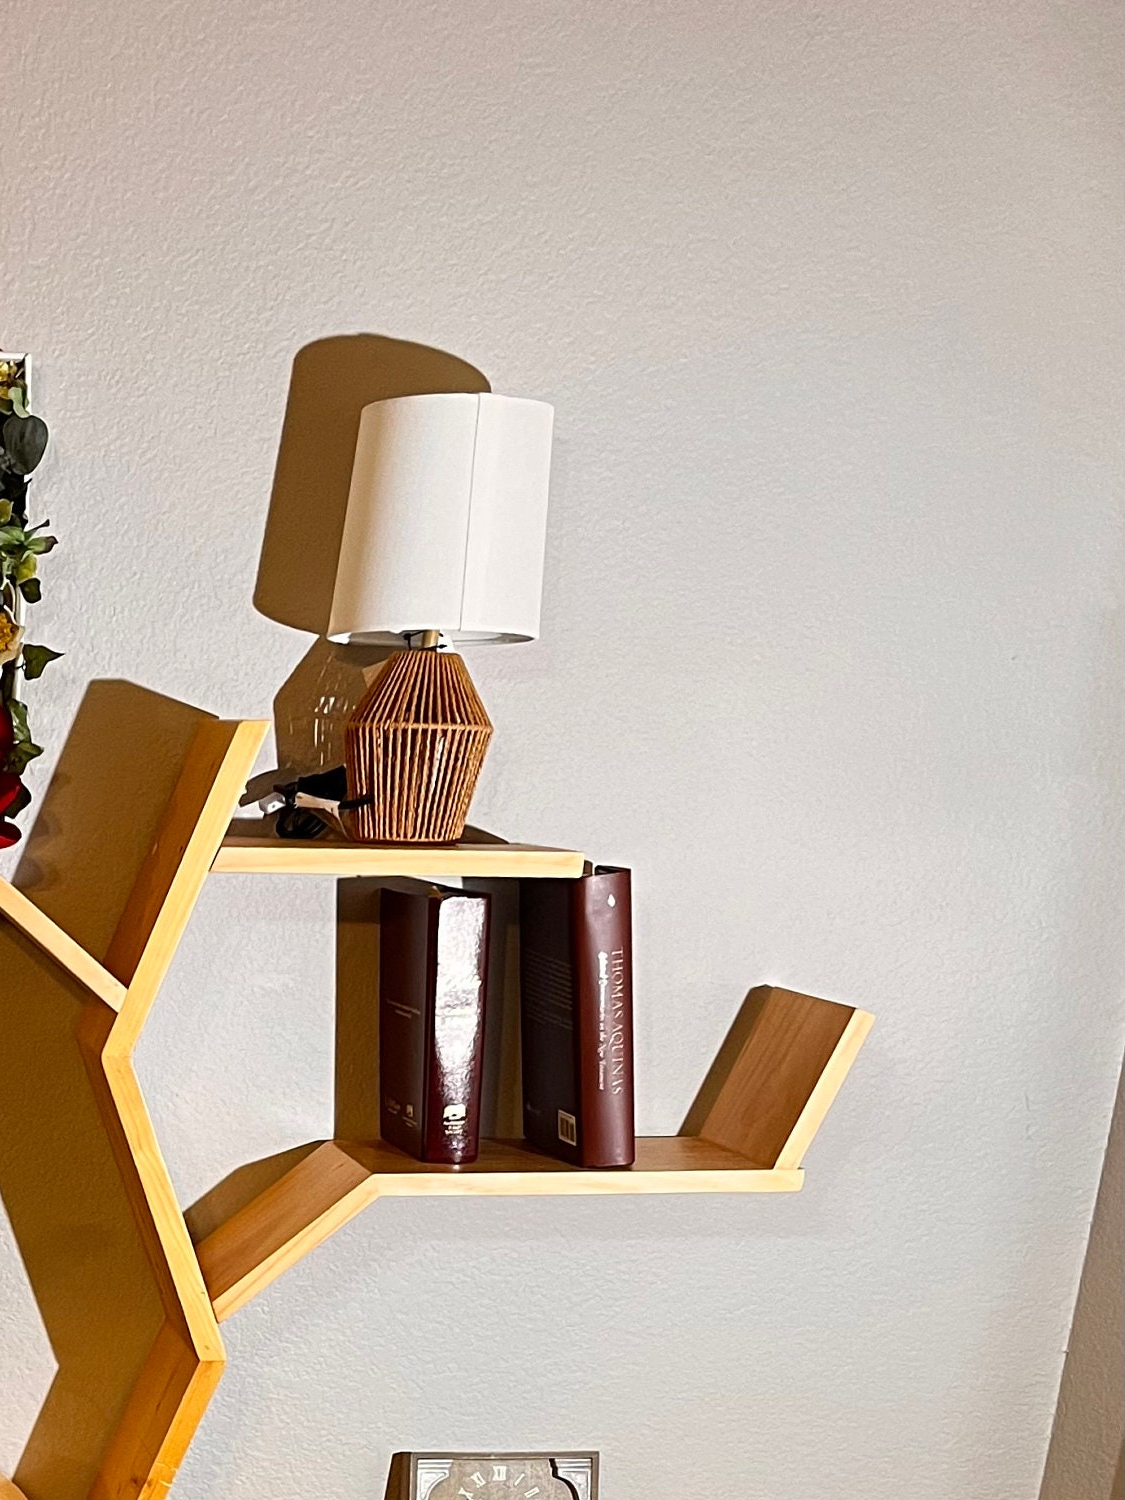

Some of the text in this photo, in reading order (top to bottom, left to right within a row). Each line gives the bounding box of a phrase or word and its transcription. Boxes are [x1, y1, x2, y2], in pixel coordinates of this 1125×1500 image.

[608, 946, 623, 1094] THOMAS AQUINAS
[492, 1465, 507, 1481] XII
